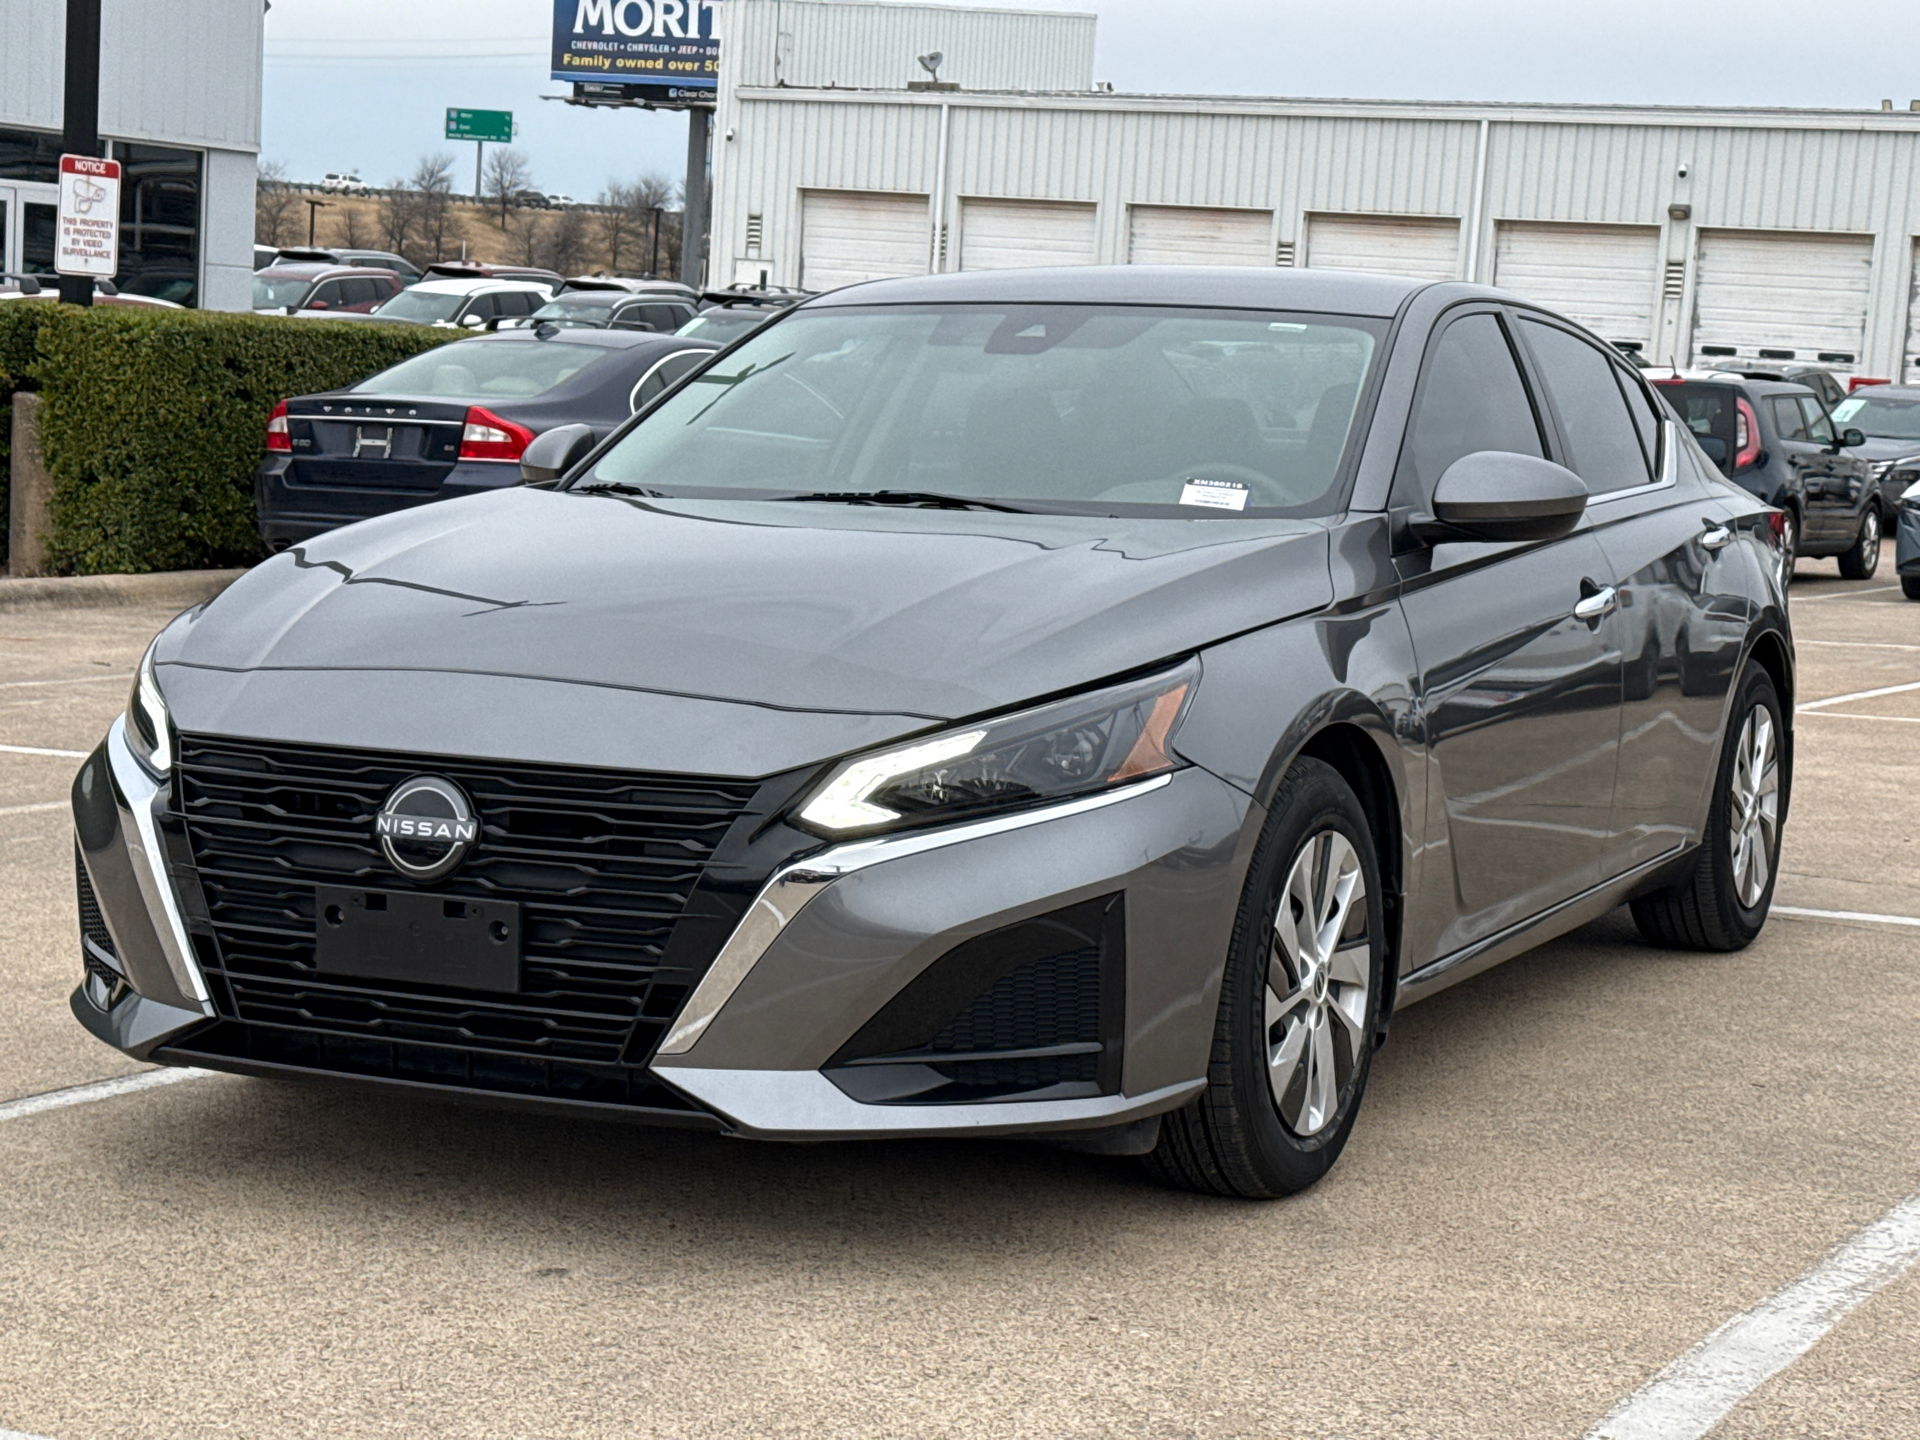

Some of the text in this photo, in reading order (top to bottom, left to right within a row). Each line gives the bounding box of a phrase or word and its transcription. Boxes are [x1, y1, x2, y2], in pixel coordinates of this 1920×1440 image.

[571, 40, 720, 56] CHEVROLET CHRYSLER JEEP DO
[563, 53, 612, 70] Family
[615, 57, 664, 69] owned
[668, 60, 700, 71] over
[74, 160, 107, 174] NOTICE
[63, 217, 113, 229] THIS PROPERTY
[64, 227, 111, 239] IS PROTECTED
[72, 238, 102, 248] BY VIDEO
[62, 247, 111, 259] SURVEILLANCE
[377, 817, 473, 839] NISSAN
